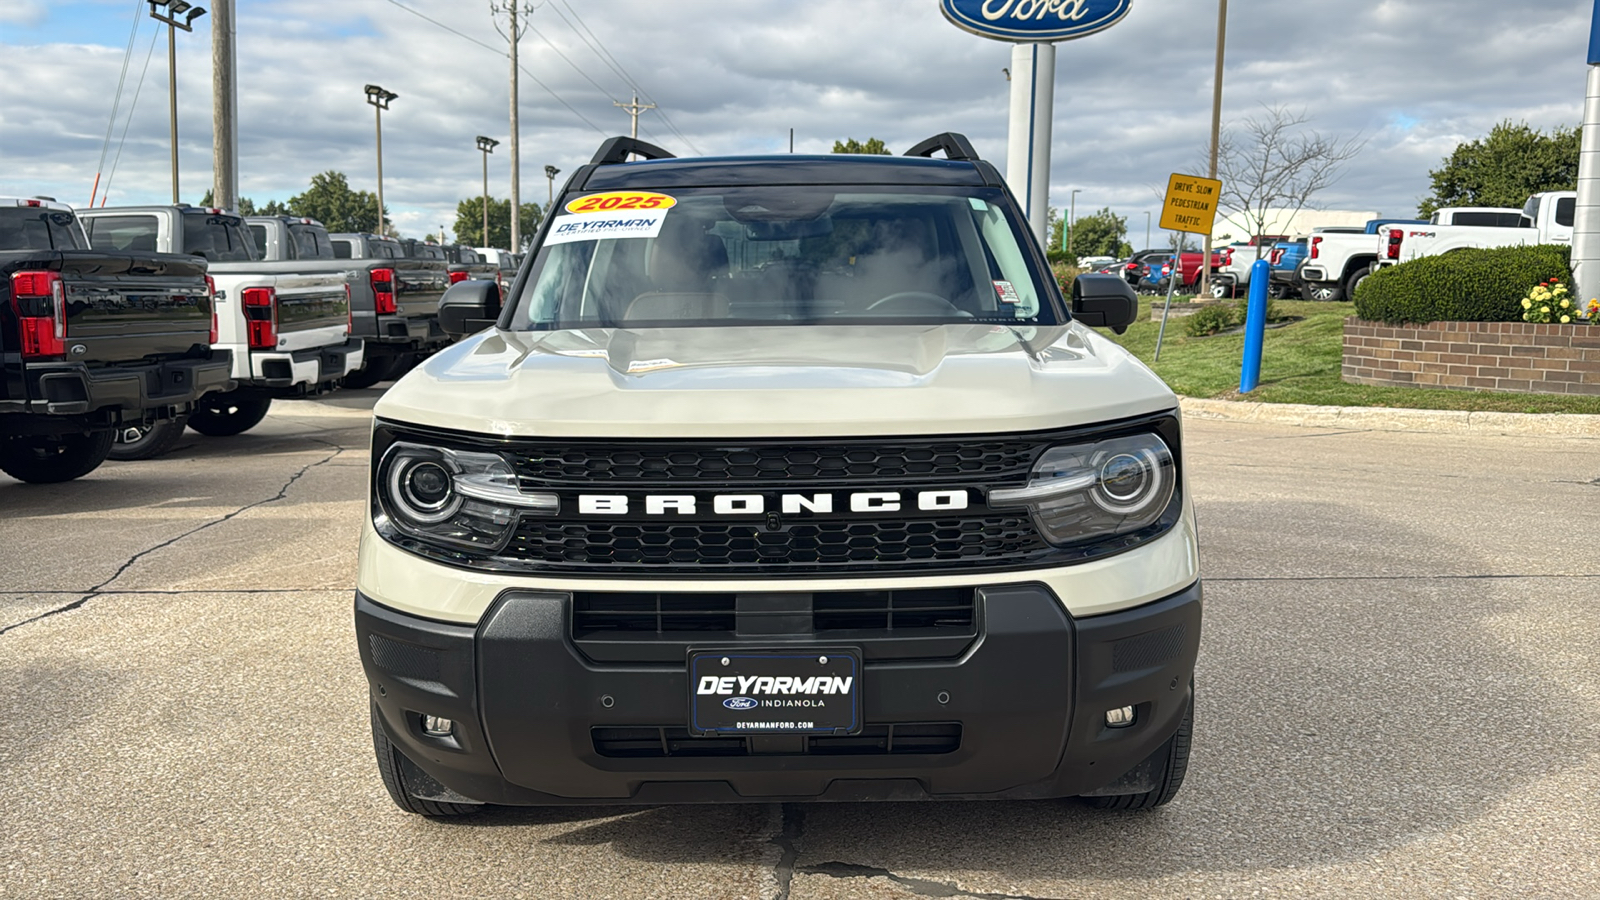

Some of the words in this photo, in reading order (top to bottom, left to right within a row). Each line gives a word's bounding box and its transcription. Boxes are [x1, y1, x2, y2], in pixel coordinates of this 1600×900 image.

[1174, 182, 1194, 193] DRIVE
[1196, 185, 1213, 195] SLOW
[575, 196, 666, 211] 2025
[1170, 197, 1210, 211] PEDESTRIAN
[556, 218, 658, 233] DEYARMAN
[1174, 214, 1201, 226] TRAFFIC
[579, 490, 968, 514] BRONCO
[696, 675, 853, 695] DEYARMAN
[729, 698, 751, 708] Ford
[761, 699, 825, 707] INDIANOLA
[736, 721, 814, 729] DEYARMANFORD.COM
